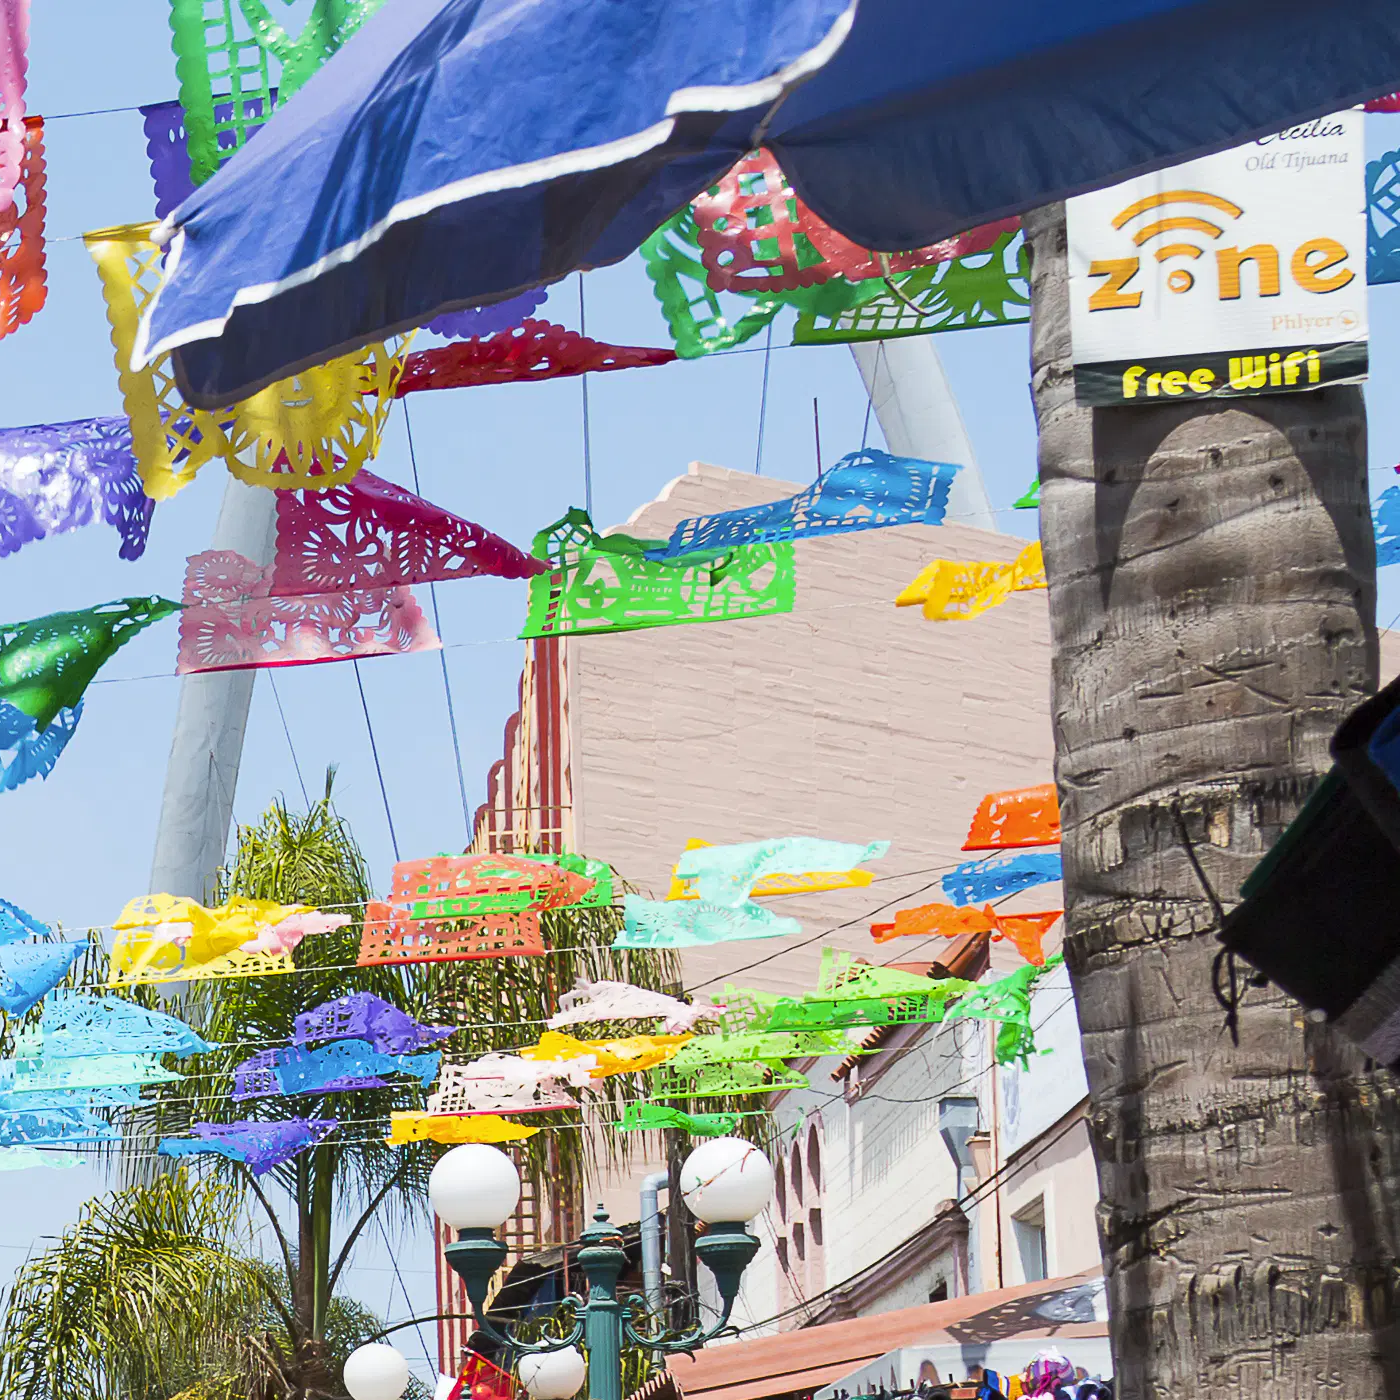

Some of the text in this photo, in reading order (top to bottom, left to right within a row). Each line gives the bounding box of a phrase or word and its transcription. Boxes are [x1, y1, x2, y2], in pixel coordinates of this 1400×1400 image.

[1245, 150, 1349, 173] Old Tijuana
[1087, 236, 1356, 313] zone
[1271, 313, 1334, 334] Phlyer
